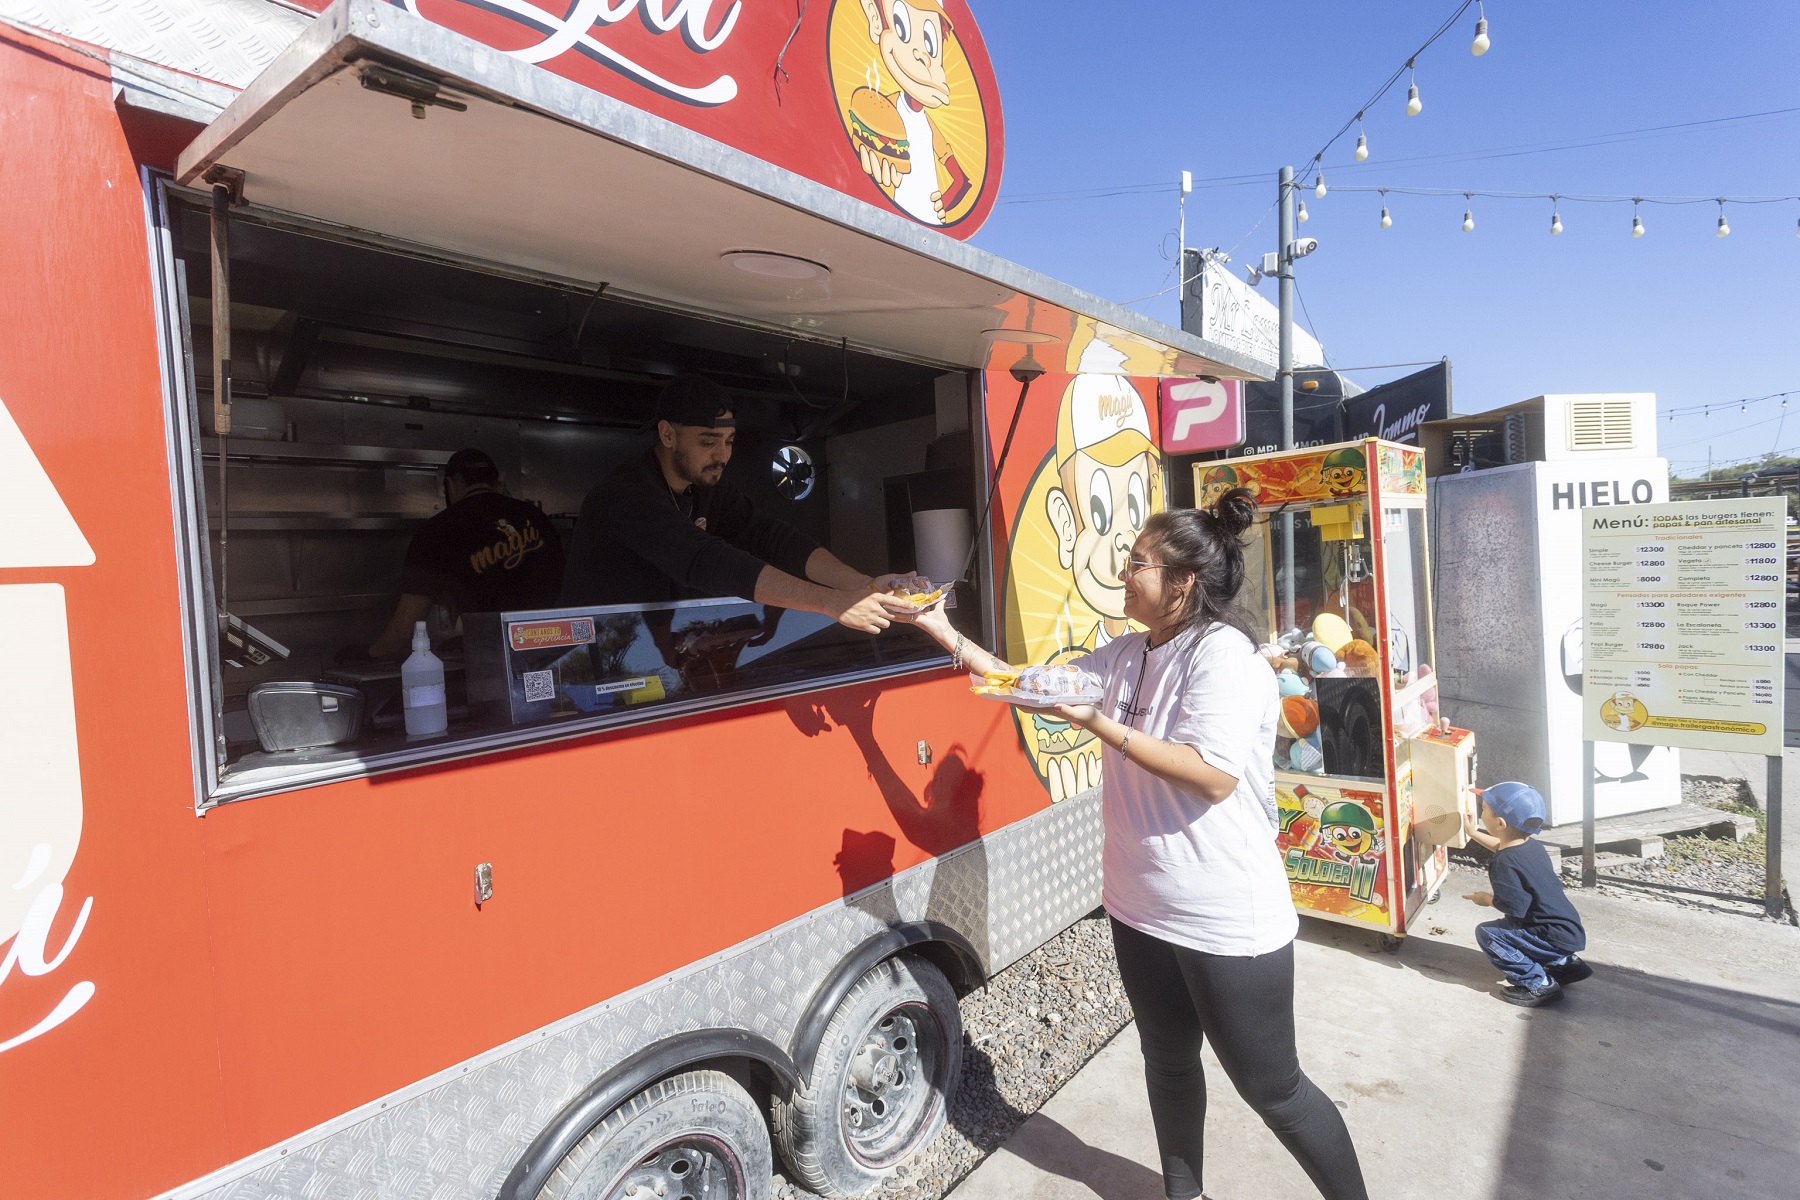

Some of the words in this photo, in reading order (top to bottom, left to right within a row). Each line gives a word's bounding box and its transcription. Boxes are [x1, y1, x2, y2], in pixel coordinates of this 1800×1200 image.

[1098, 386, 1134, 429] magú
[1552, 479, 1653, 510] HIELO
[1592, 515, 1649, 530] Menú:
[1652, 514, 1684, 523] TODAS
[1701, 512, 1738, 521] burgers
[1740, 511, 1775, 519] tienen:
[1652, 521, 1683, 529] papas
[1693, 519, 1713, 527] pan
[1715, 517, 1762, 526] artesanal
[470, 520, 544, 573] magú
[1745, 557, 1777, 565] $11800
[1745, 574, 1779, 582] $12800
[1744, 644, 1776, 652] $13300
[1284, 846, 1353, 888] SOLDIER
